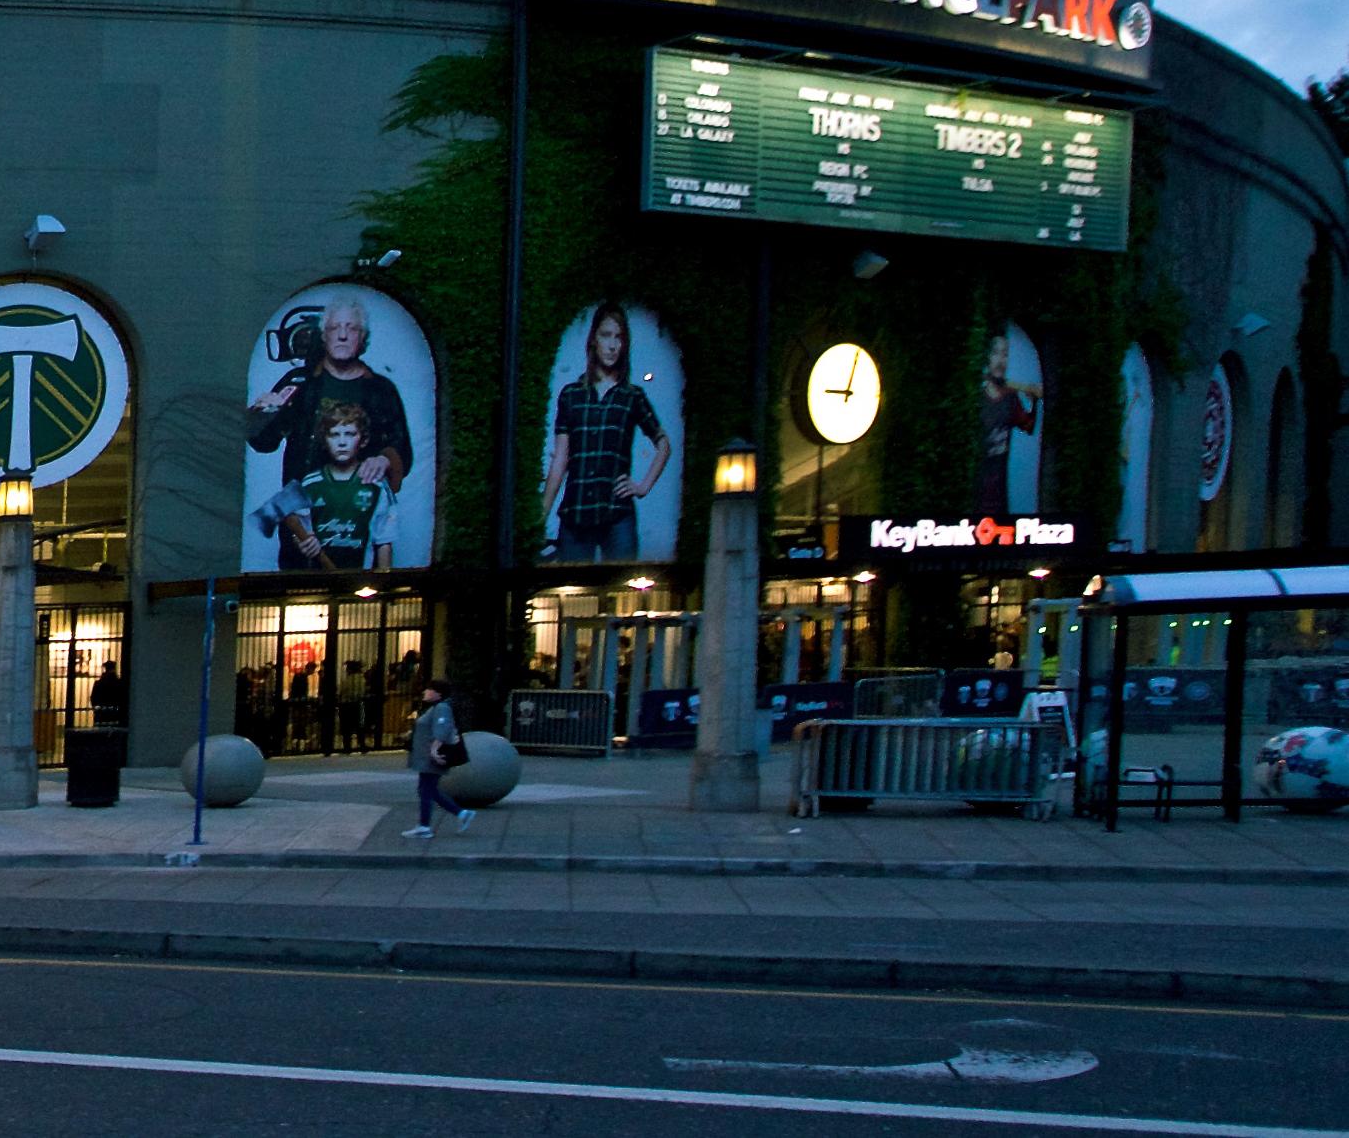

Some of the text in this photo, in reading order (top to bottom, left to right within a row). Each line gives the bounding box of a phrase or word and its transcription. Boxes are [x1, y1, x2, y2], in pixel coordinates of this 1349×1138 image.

[808, 106, 882, 142] THORNS
[933, 122, 1023, 158] TIMBERS 2
[870, 517, 1075, 552] KeyBank Plaza
